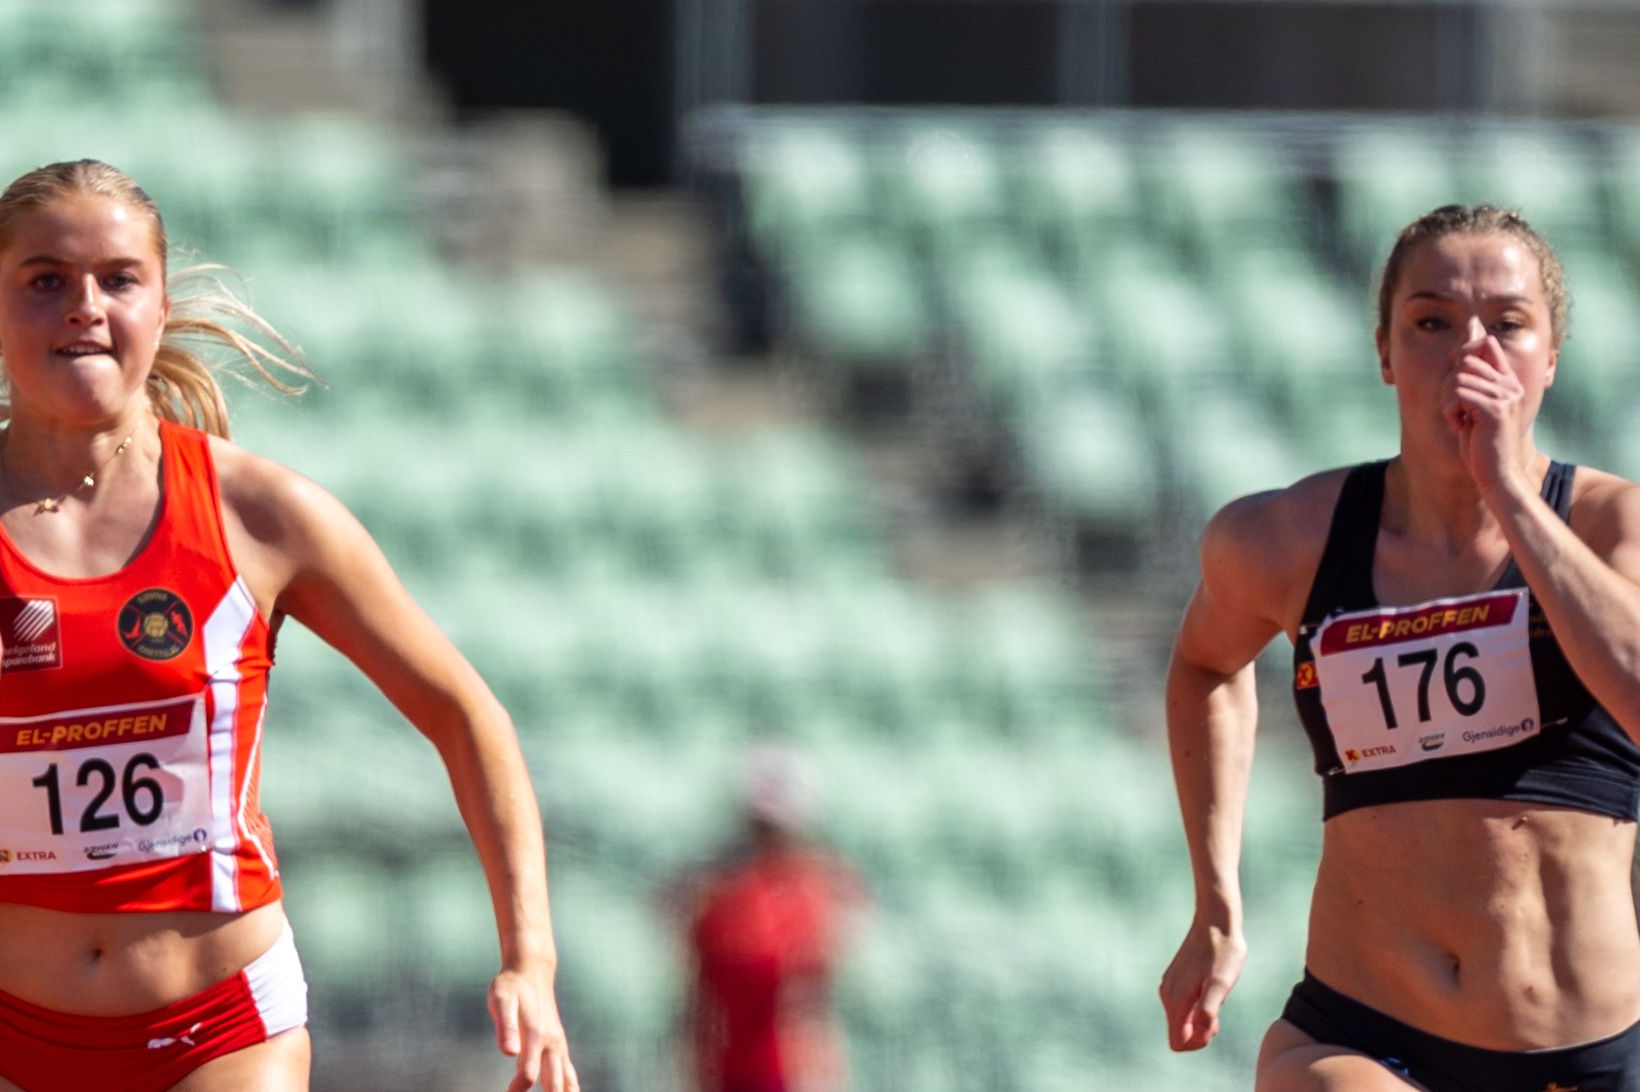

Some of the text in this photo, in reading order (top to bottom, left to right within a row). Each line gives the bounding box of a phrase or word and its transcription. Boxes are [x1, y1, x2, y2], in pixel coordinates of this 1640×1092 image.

[1344, 604, 1491, 644] EL-PROFFEN
[1361, 641, 1486, 730] 176
[15, 713, 168, 746] EL-PROFFEN
[1361, 744, 1397, 758] EXTRA
[31, 752, 164, 836] 126
[15, 850, 57, 862] EXTRA
